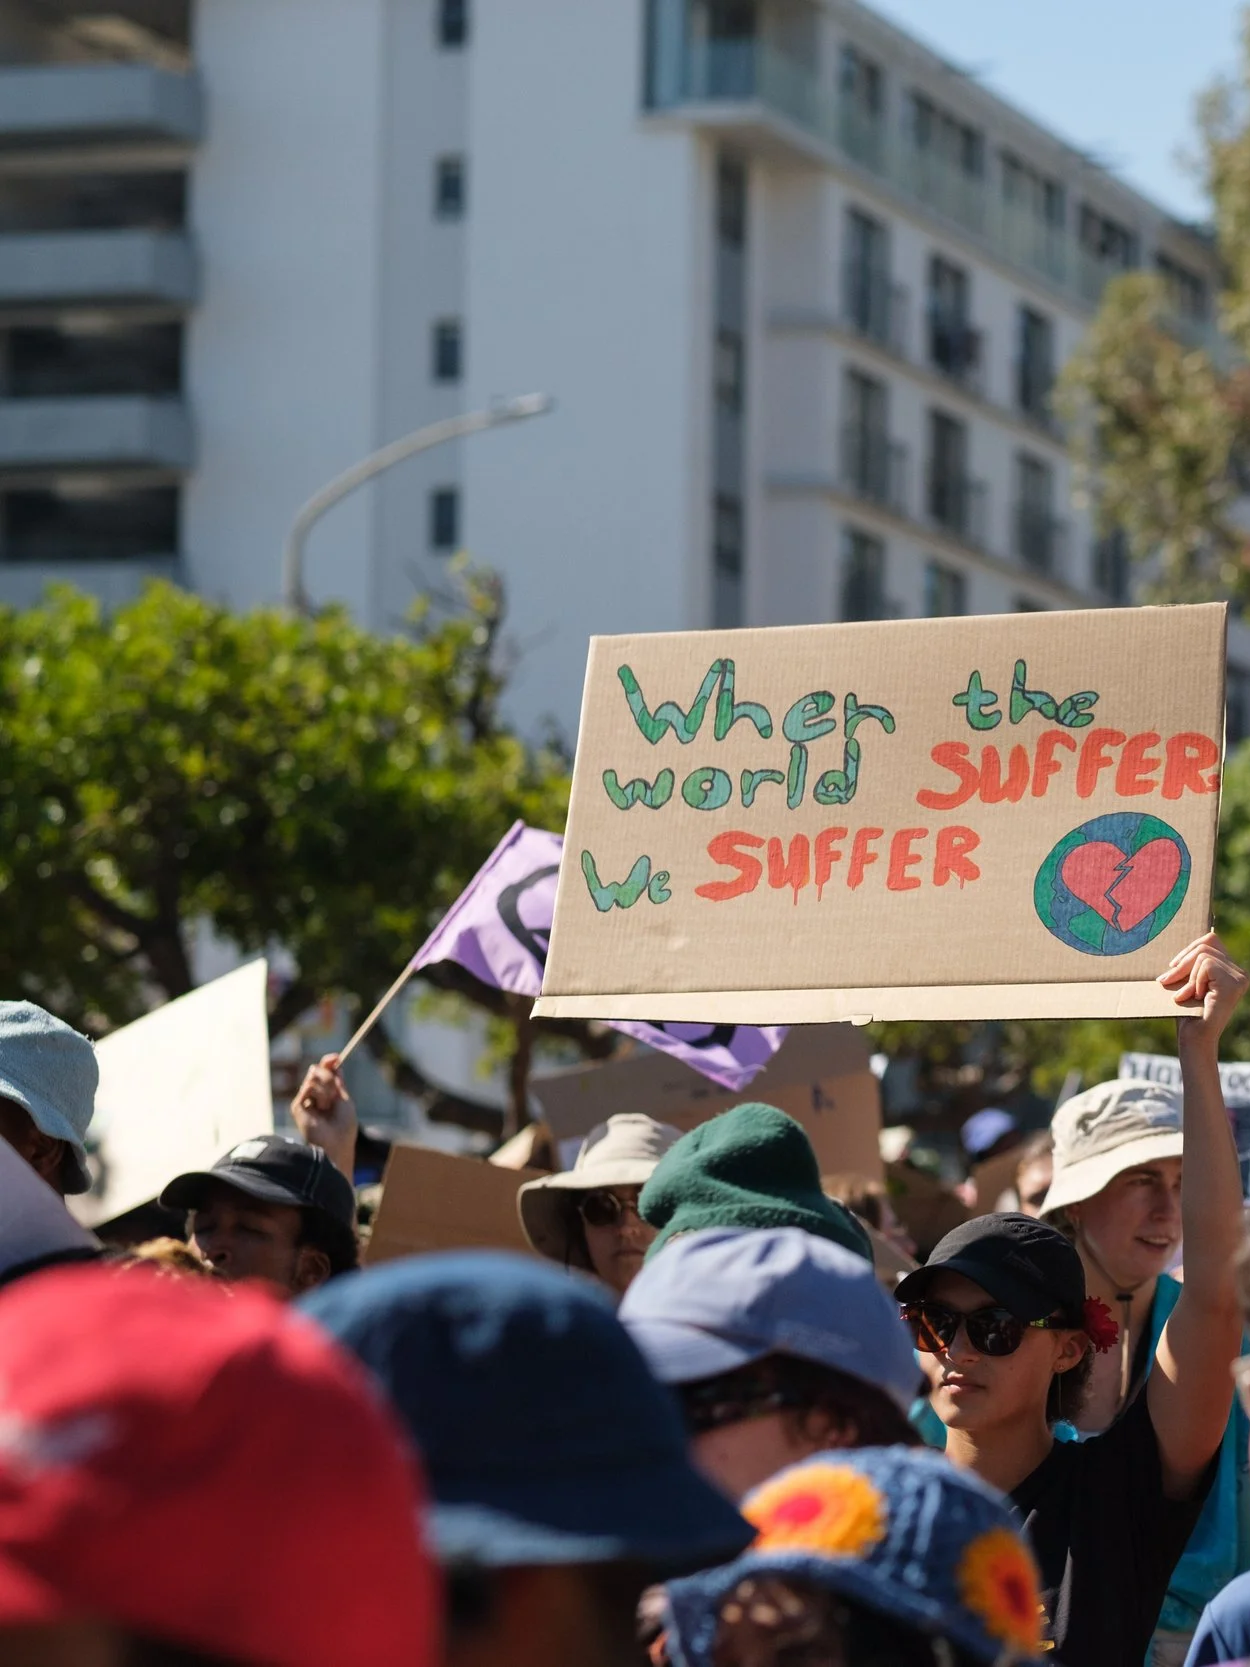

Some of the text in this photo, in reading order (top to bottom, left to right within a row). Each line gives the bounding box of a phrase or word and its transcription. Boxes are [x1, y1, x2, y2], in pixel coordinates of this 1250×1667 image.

[617, 657, 1100, 745] When the
[602, 737, 861, 811] world
[581, 825, 981, 912] We SUFFER
